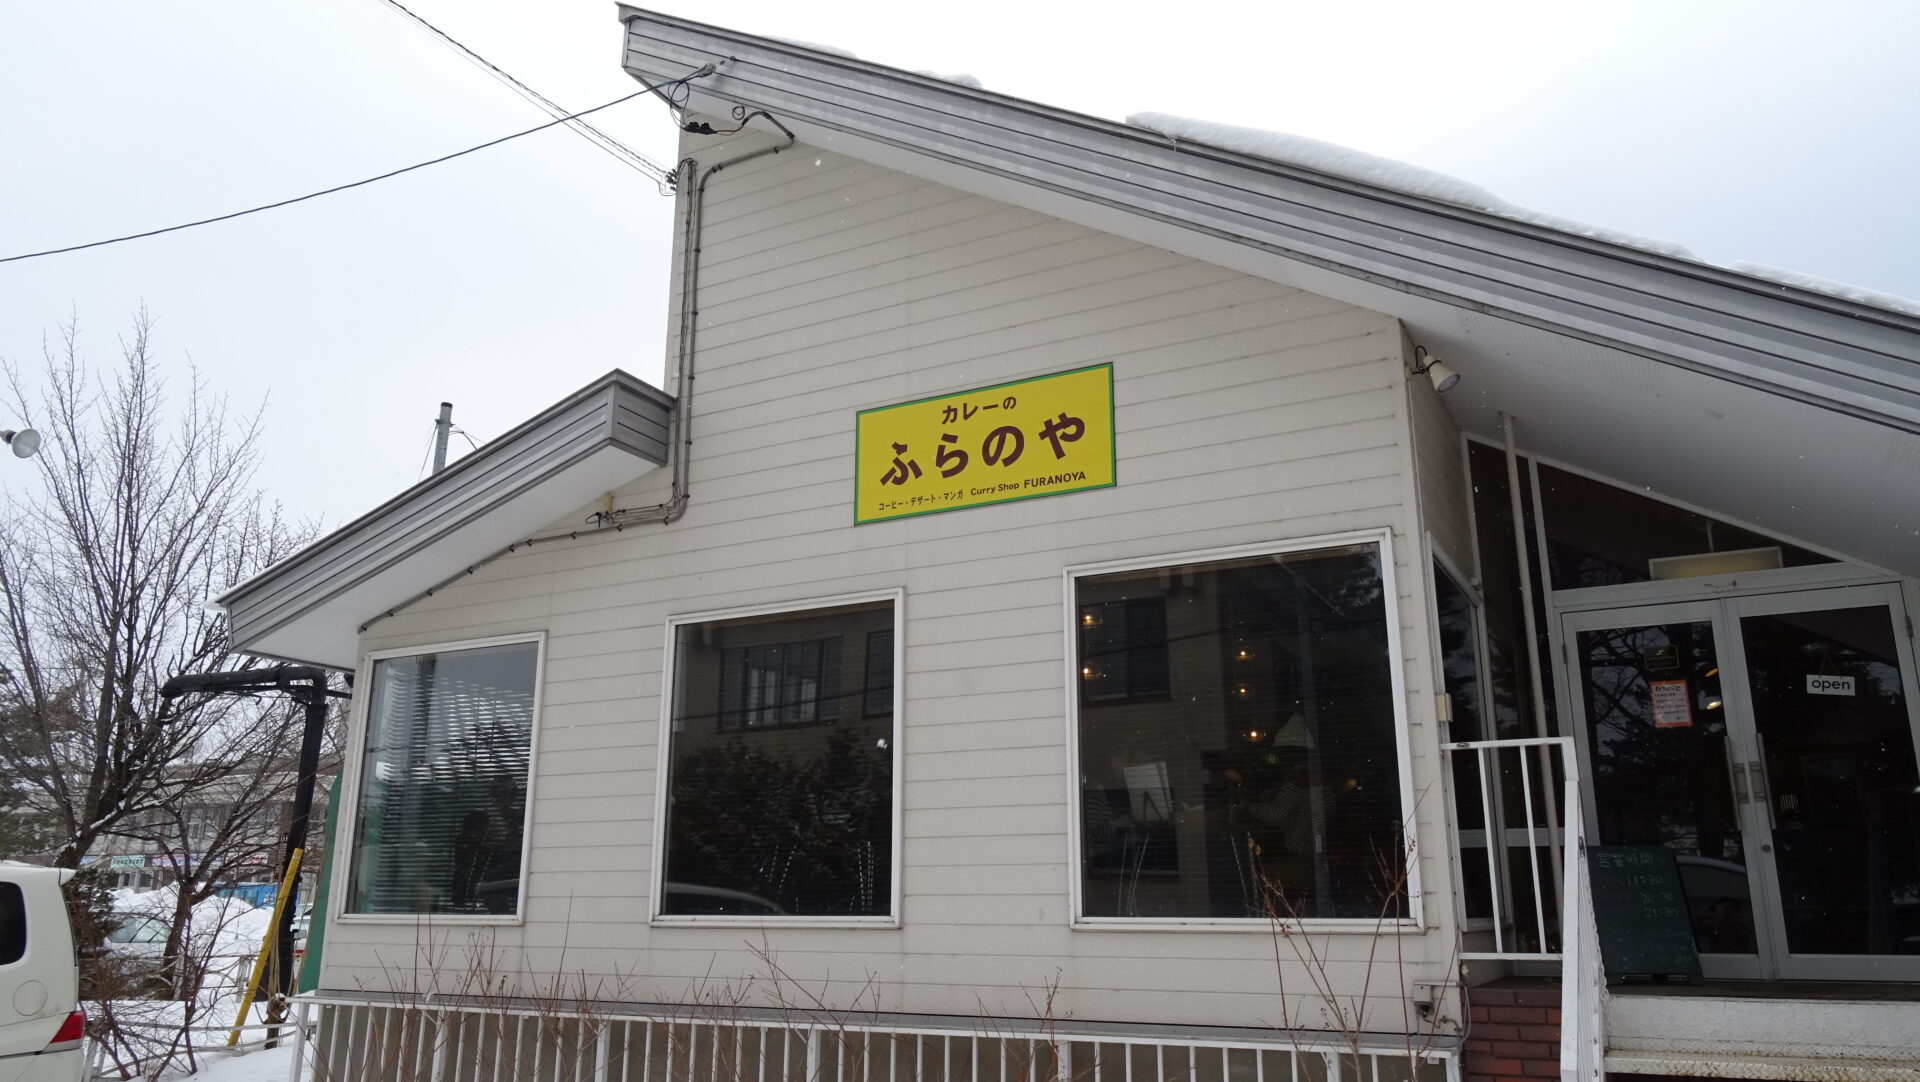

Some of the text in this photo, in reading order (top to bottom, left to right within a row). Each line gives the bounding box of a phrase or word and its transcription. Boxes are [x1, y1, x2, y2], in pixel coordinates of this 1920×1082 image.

[941, 396, 1017, 425] カレーの
[879, 412, 1086, 487] ふらのや
[970, 471, 1087, 496] Curry Shop FURANOYA
[1811, 679, 1851, 692] open
